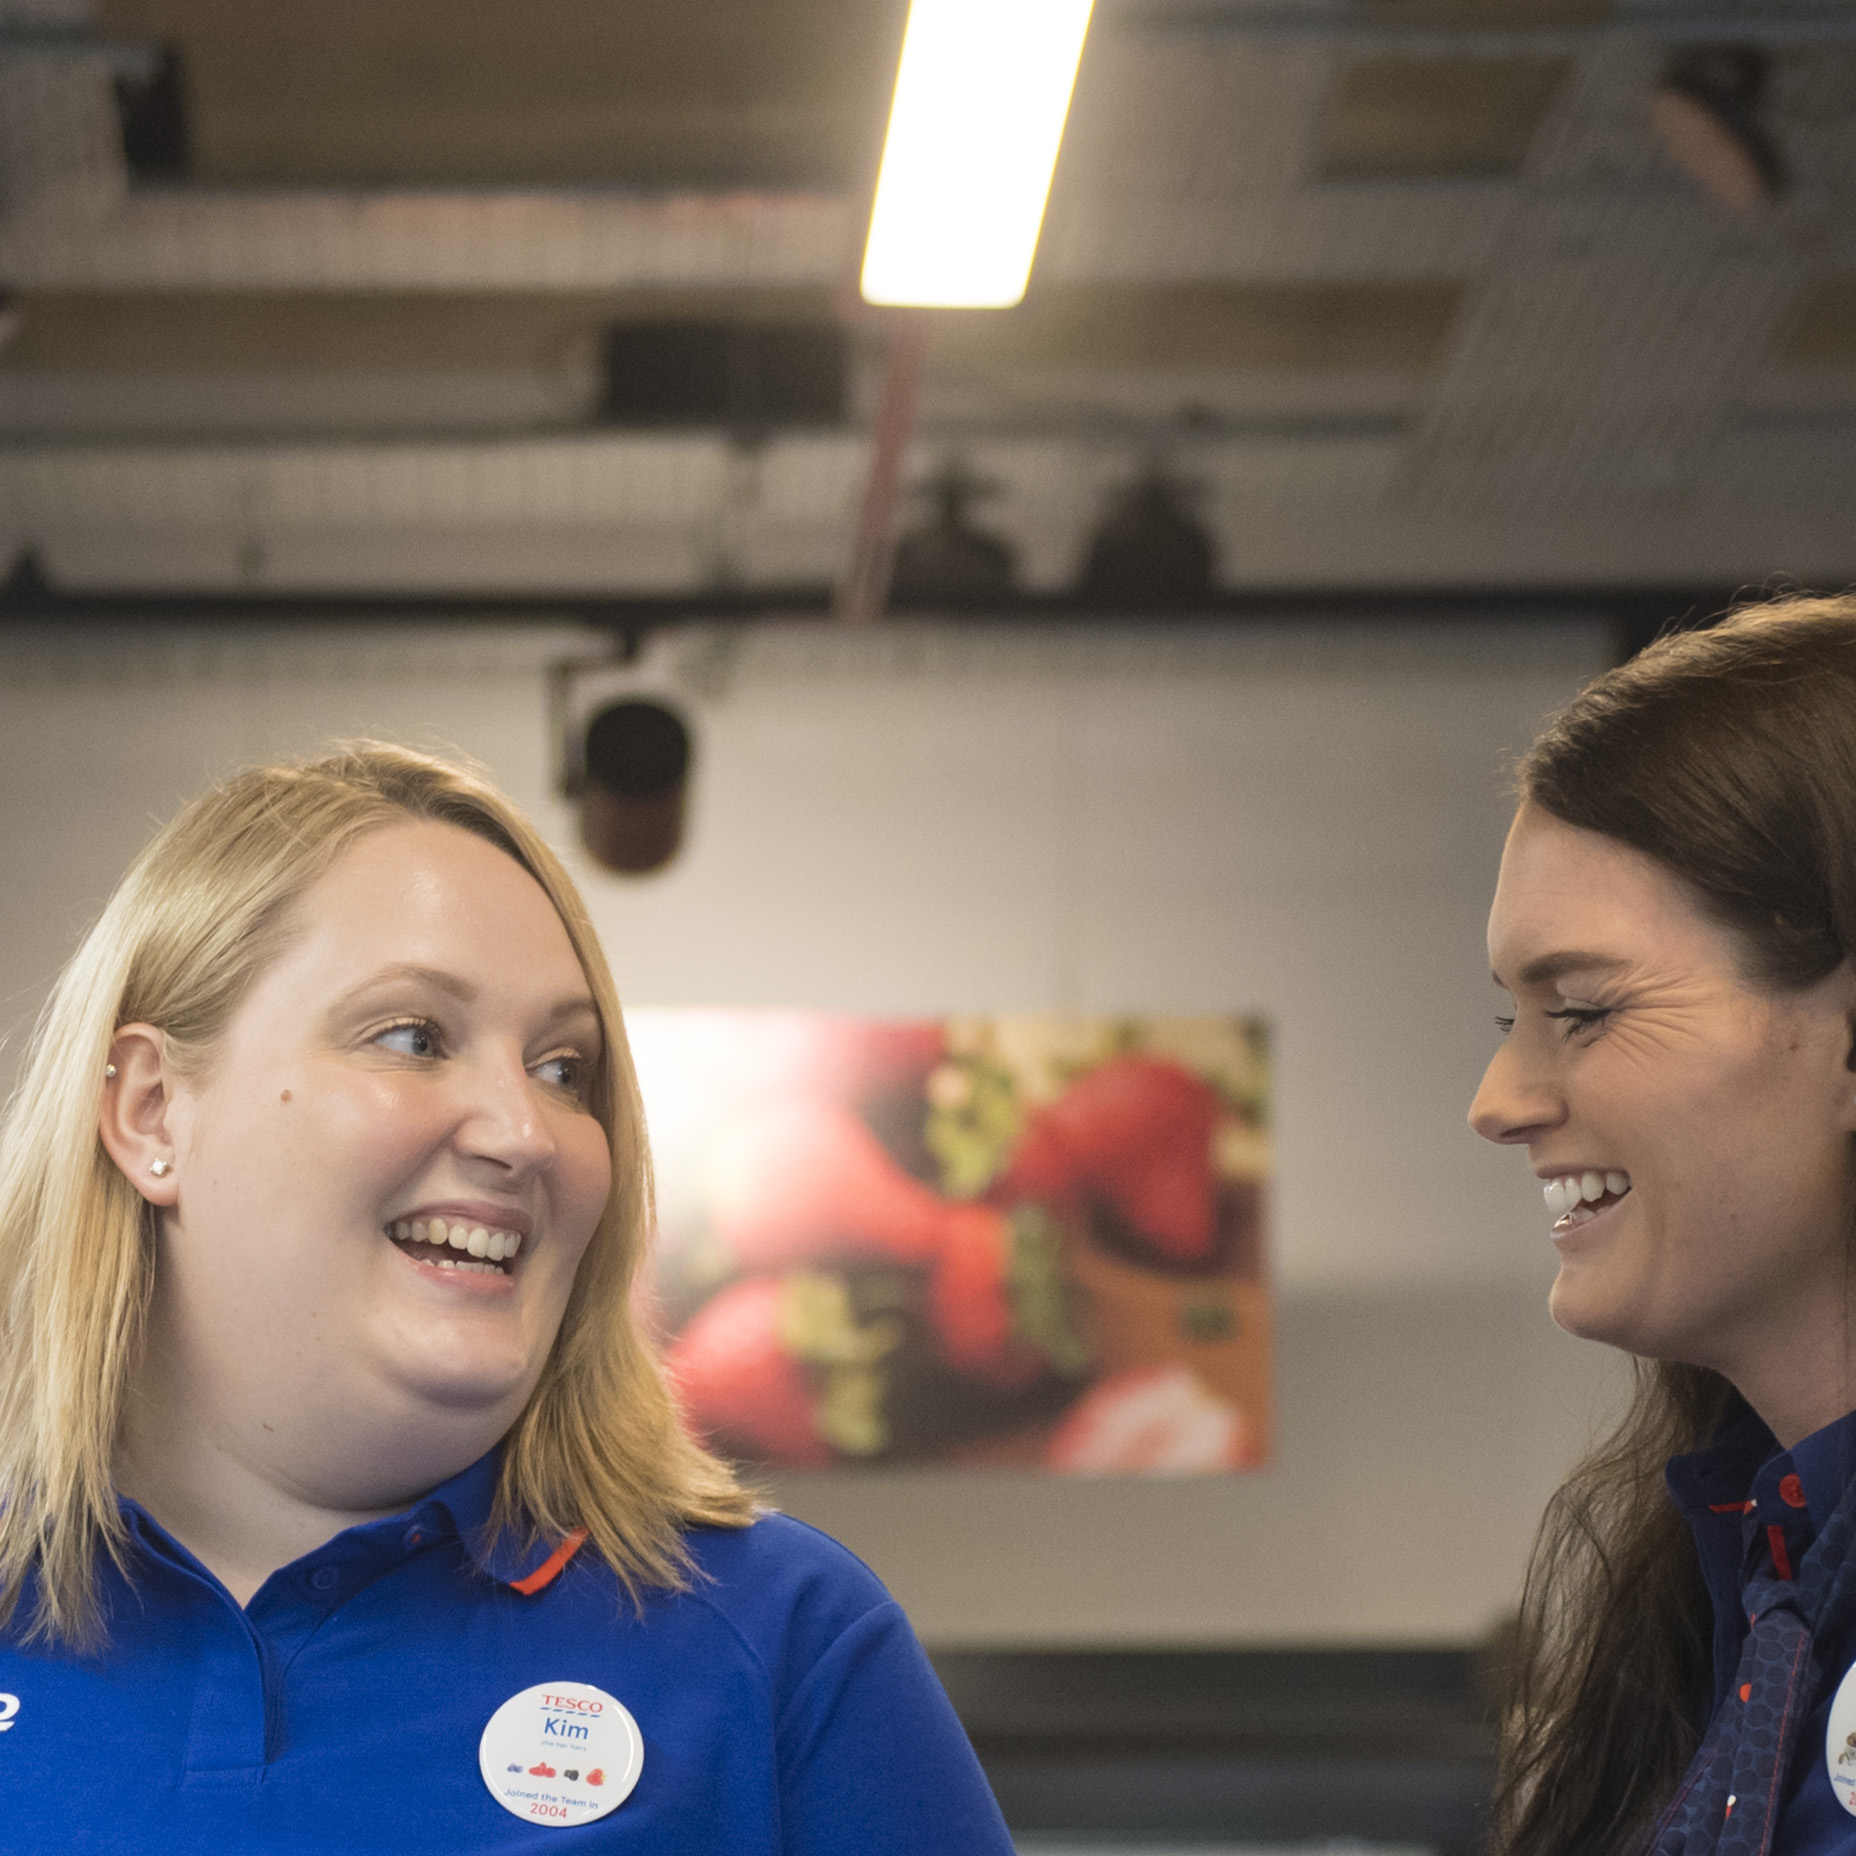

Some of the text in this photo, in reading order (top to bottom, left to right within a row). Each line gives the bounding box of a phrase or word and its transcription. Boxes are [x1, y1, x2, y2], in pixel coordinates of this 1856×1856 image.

[541, 1694, 604, 1714] TESCO
[544, 1717, 590, 1740] Kim
[504, 1788, 599, 1810] Joined the Team in
[530, 1802, 568, 1819] 2004
